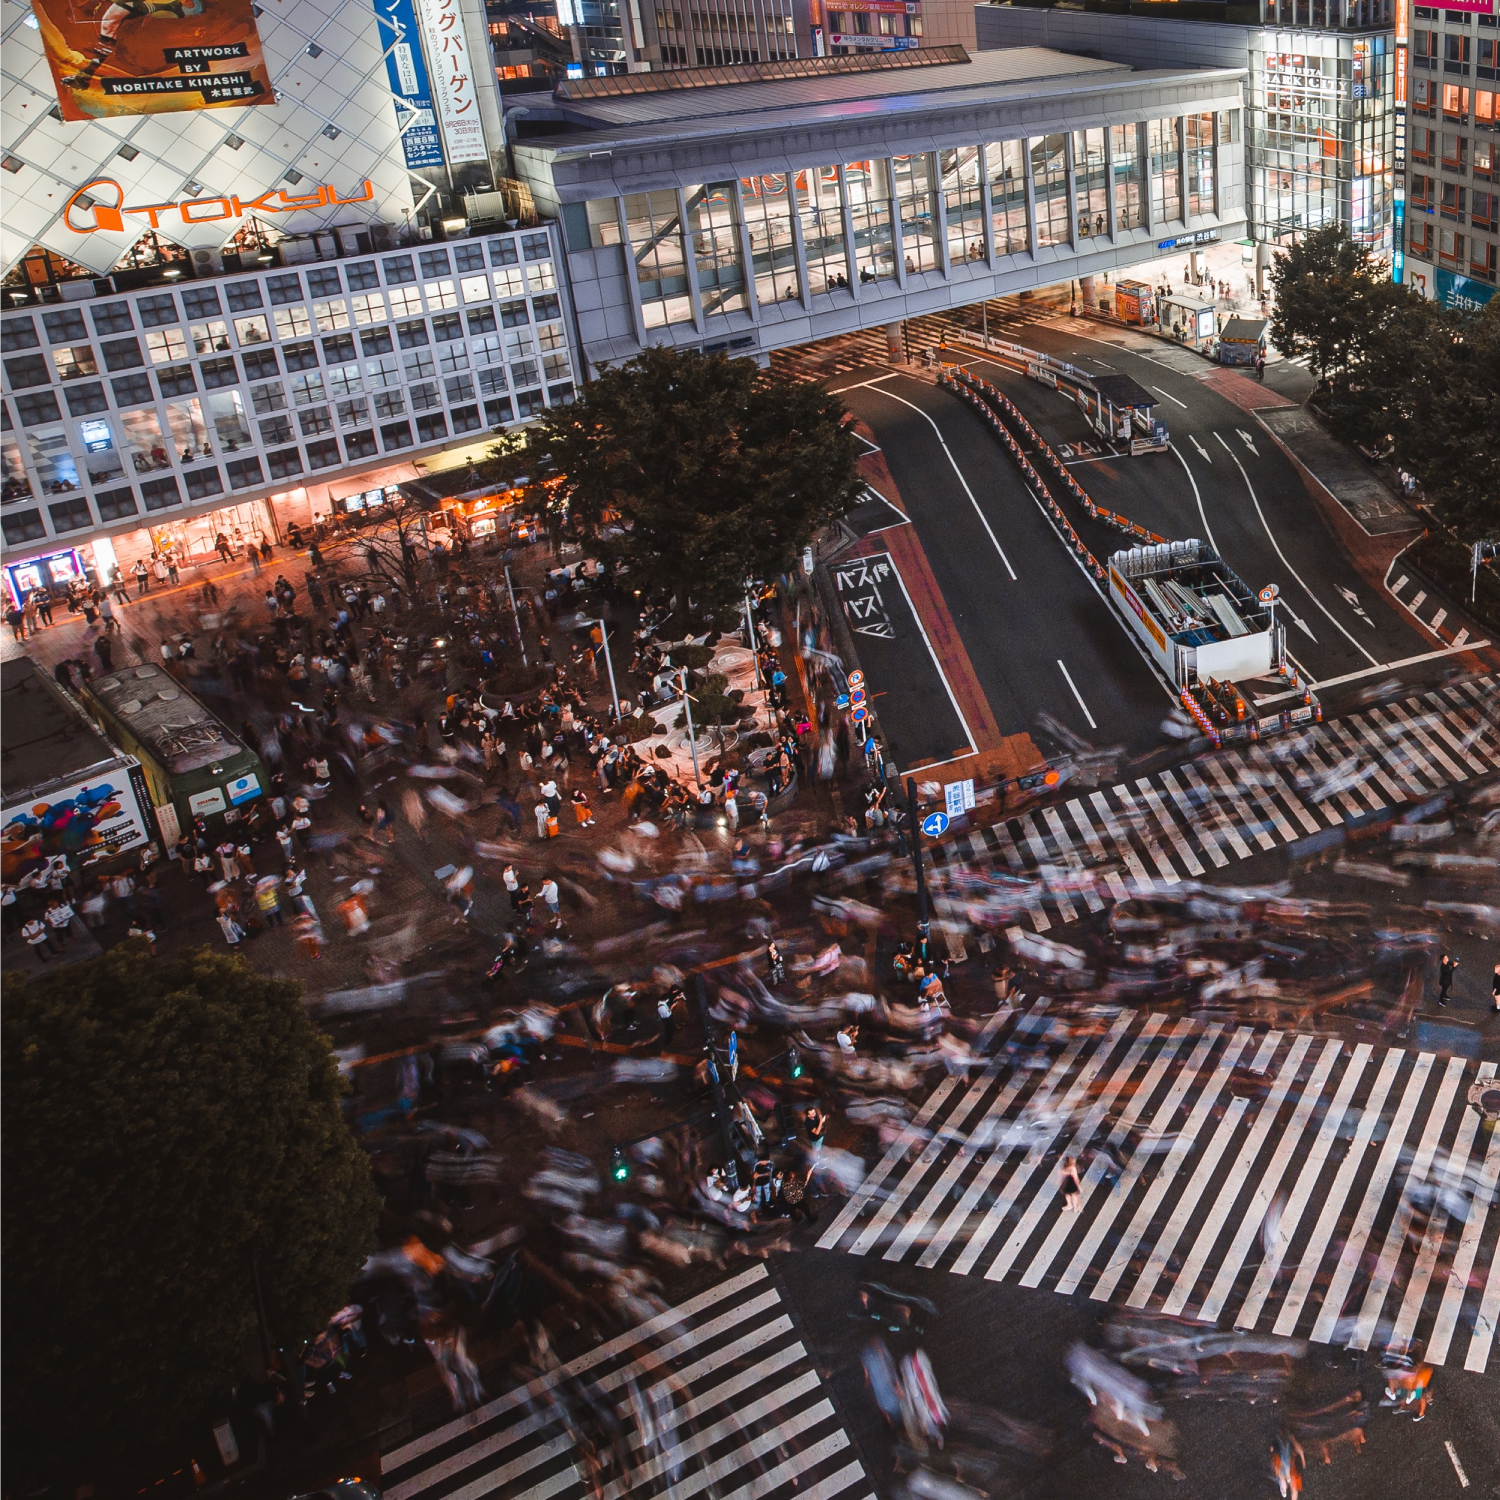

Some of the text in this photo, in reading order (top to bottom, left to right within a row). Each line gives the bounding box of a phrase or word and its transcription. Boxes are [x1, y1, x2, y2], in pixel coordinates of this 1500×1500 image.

[174, 47, 241, 59] ARTWORK
[185, 64, 201, 73] BY
[1278, 64, 1321, 76] SHIBUYA
[112, 75, 245, 93] NORITAKE KINASHI
[1262, 73, 1347, 91] MARK CITY
[211, 86, 254, 98] 木梨憲武
[406, 144, 438, 152] カスタマー
[123, 180, 374, 228] TOKYU
